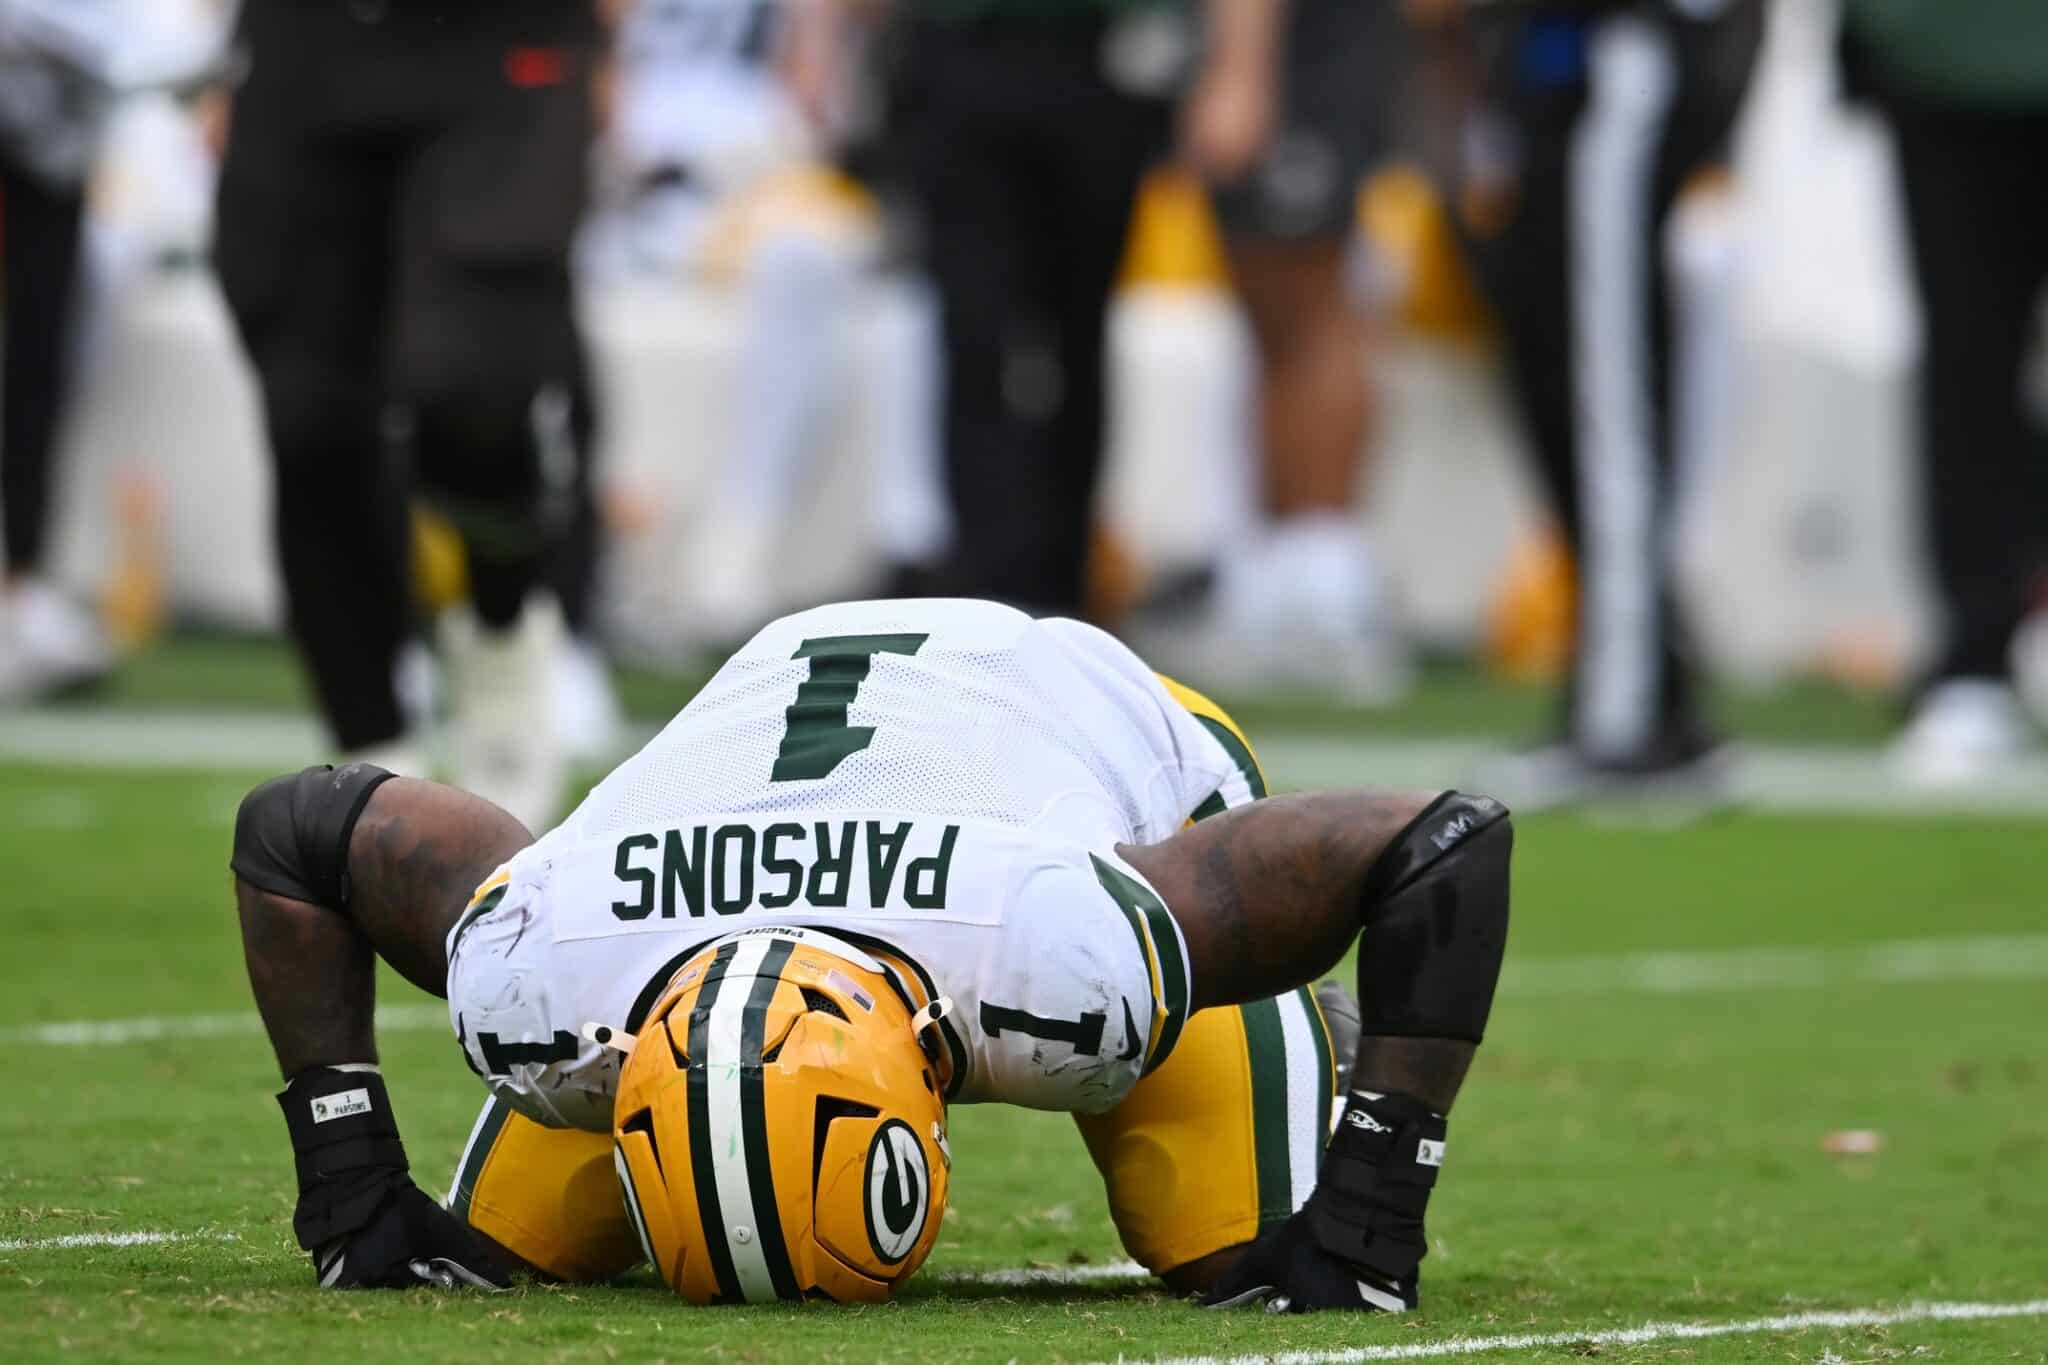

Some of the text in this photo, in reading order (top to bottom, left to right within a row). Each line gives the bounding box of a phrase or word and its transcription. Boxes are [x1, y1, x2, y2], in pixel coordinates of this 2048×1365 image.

[770, 633, 930, 782] 1
[611, 820, 960, 921] PARSONS
[477, 1029, 579, 1075] 1
[980, 999, 1106, 1056] 1
